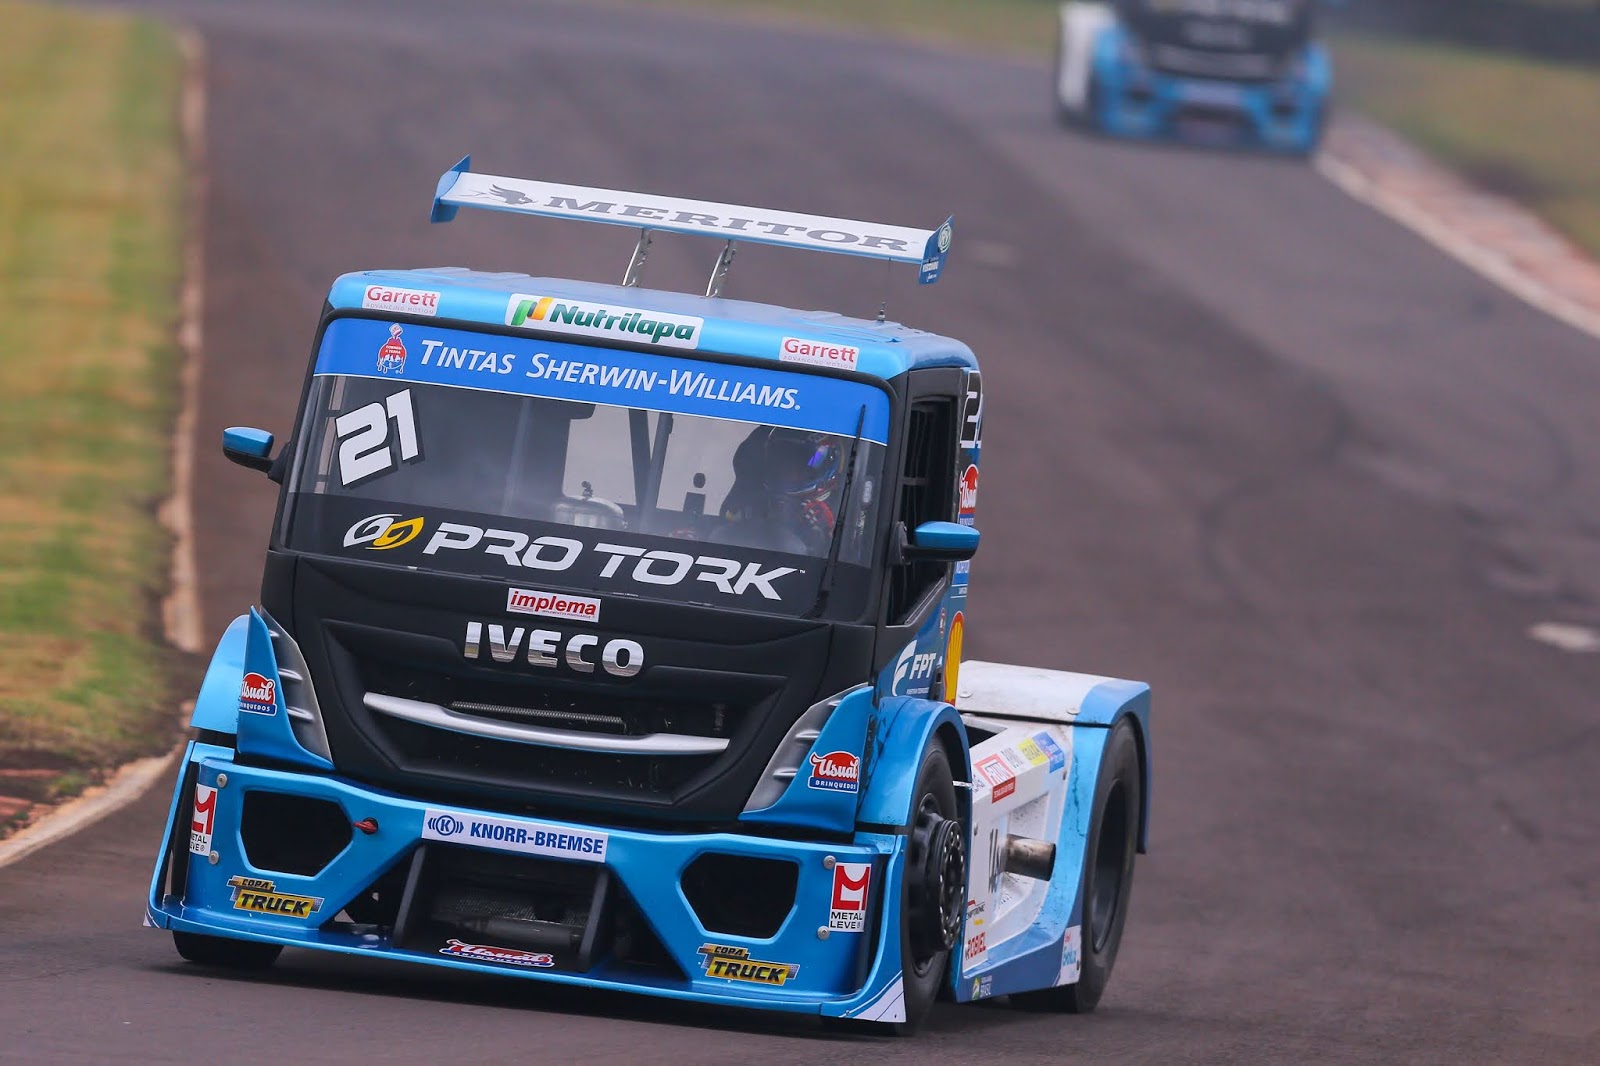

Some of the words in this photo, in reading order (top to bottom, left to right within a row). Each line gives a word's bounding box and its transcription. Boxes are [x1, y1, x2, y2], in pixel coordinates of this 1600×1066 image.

[543, 195, 907, 252] MERITOR
[367, 286, 437, 307] Garrett
[365, 303, 405, 311] ADVANCING
[407, 307, 434, 315] MOTION
[549, 303, 696, 343] Nutrilapa
[782, 355, 824, 364] ADVANCING
[826, 361, 854, 370] MOTION
[784, 338, 856, 363] Garrett
[420, 339, 515, 374] TINTAS
[526, 352, 799, 410] SHERWIN-WILLIAMS
[336, 388, 419, 486] 21
[422, 522, 584, 571] PRO
[593, 542, 798, 601] TORK
[510, 591, 597, 615] implema
[463, 621, 644, 678] IVECO
[909, 652, 937, 680] FPT
[812, 755, 858, 779] Usual
[815, 779, 857, 790] BRINQUEDOS
[470, 822, 604, 855] KNORR-BREMSE
[242, 879, 269, 889] COPA
[241, 893, 310, 915] TRUCK
[830, 911, 863, 921] METAL
[714, 946, 744, 956] COPA
[713, 961, 786, 982] TRUCK
